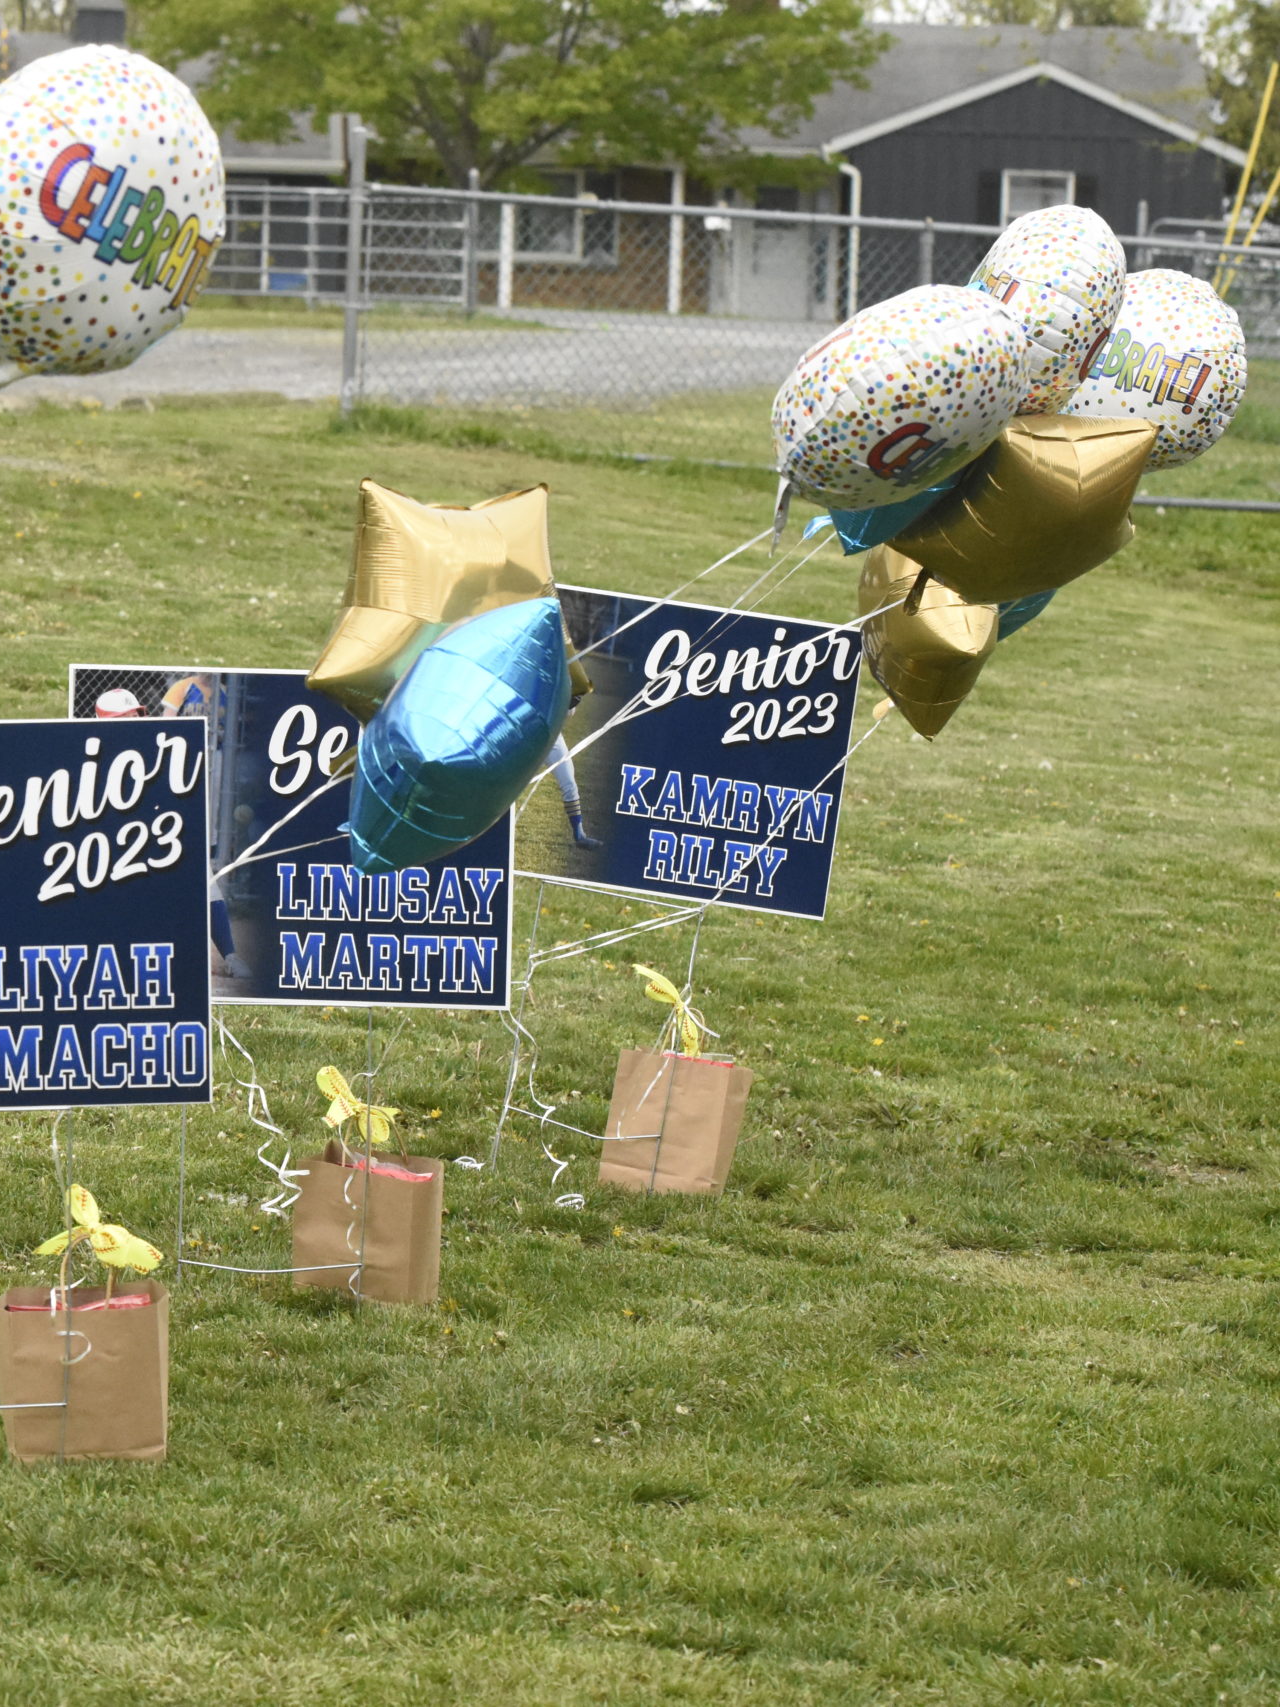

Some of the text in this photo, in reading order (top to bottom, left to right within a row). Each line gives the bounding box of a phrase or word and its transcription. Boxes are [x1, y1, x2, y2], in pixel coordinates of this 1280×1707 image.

[642, 627, 862, 707] Senior
[721, 692, 839, 744] 2023
[616, 764, 833, 843] KAMRYN
[37, 811, 184, 902] 2023
[643, 829, 787, 897] RILEY
[276, 863, 504, 925] LINDSAY
[279, 931, 498, 994] MARTIN
